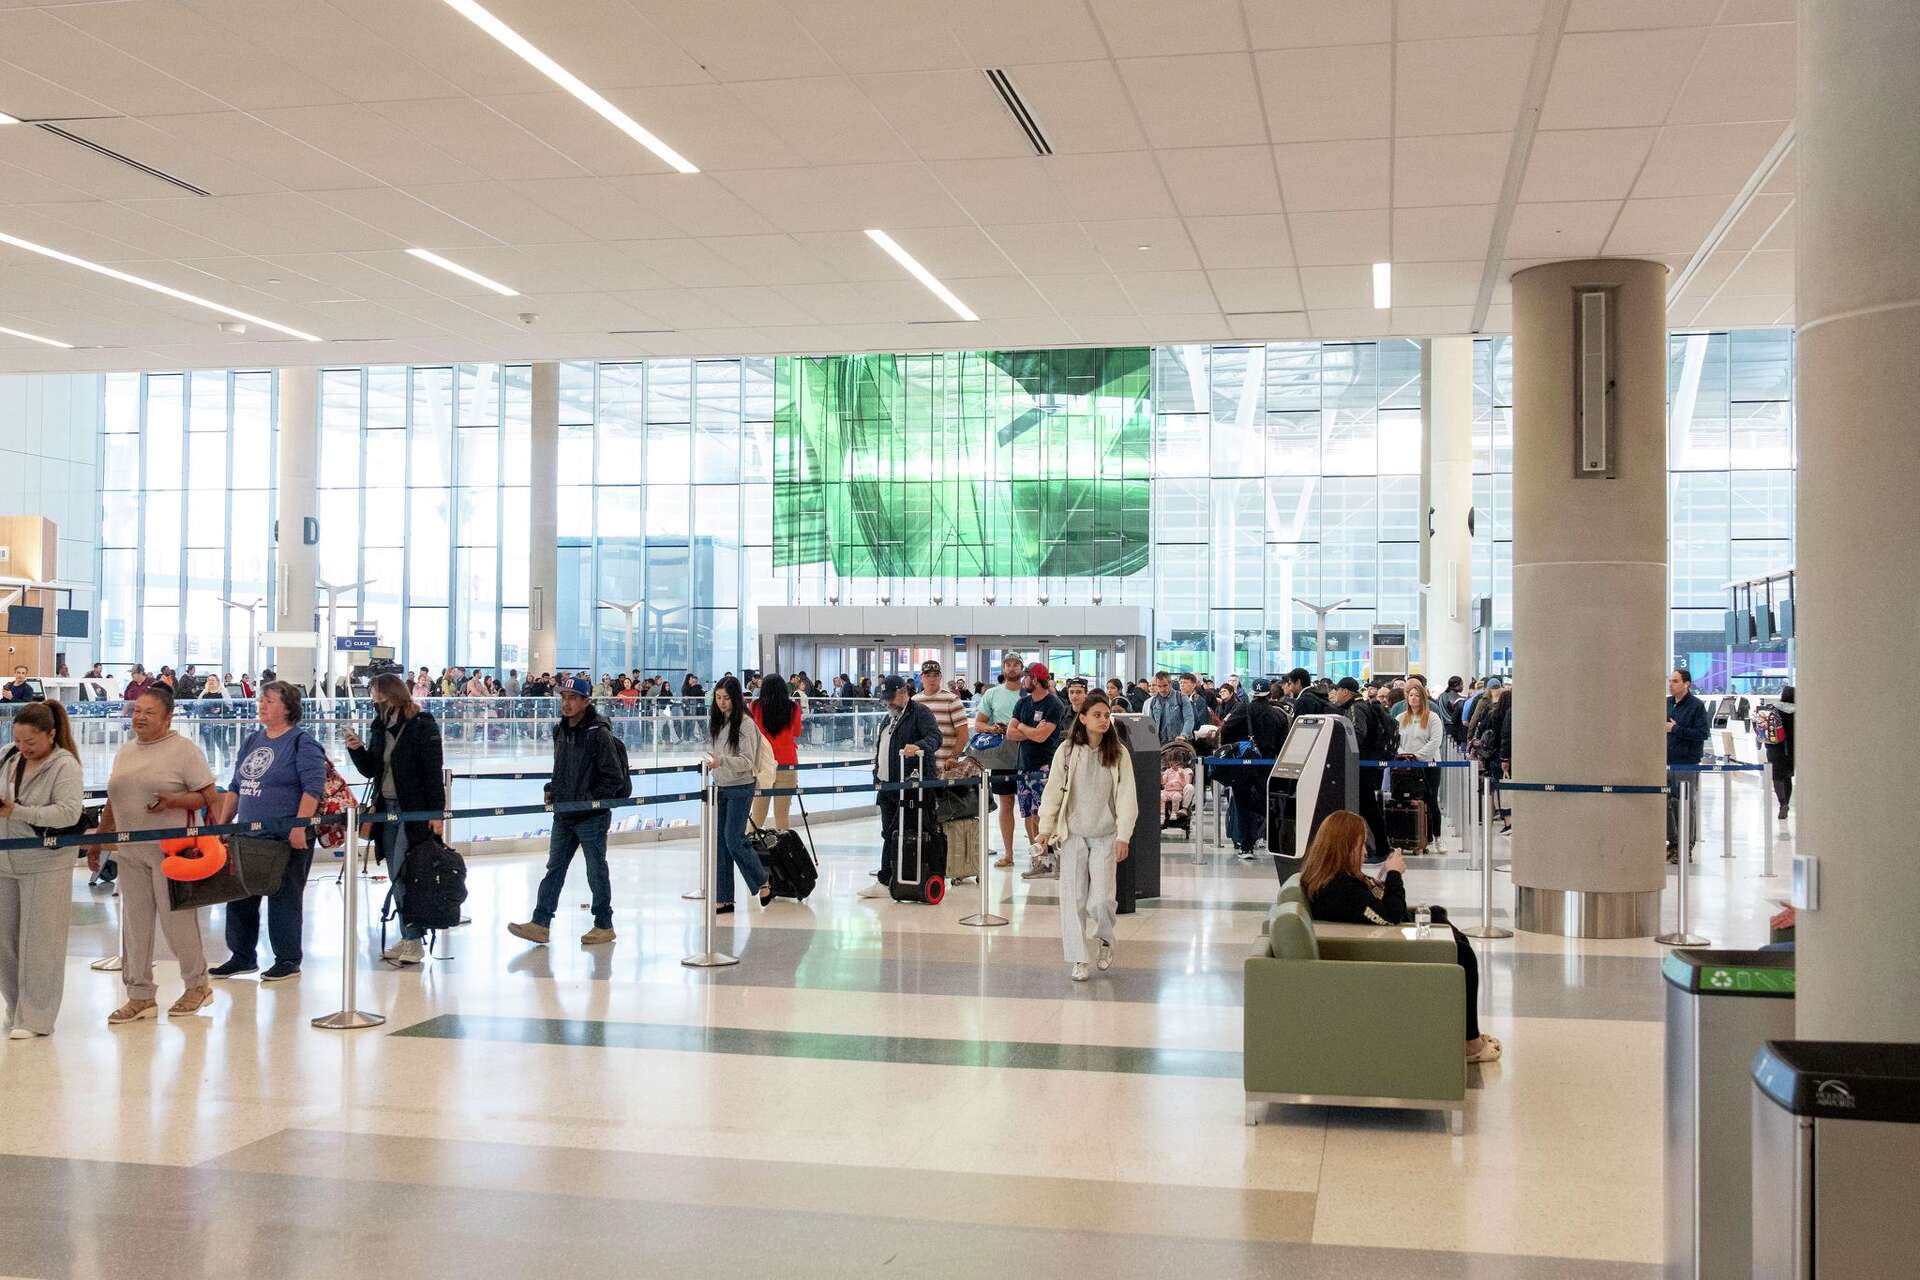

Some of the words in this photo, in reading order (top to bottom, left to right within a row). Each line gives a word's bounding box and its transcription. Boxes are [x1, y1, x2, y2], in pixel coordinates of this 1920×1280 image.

[304, 517, 320, 544] D
[1680, 658, 1687, 668] 3
[311, 817, 321, 825] IAH
[387, 812, 398, 821] IAH
[251, 822, 261, 831] IAH
[187, 828, 198, 836] IAH
[118, 833, 130, 841] IAH
[44, 837, 56, 847] IAH
